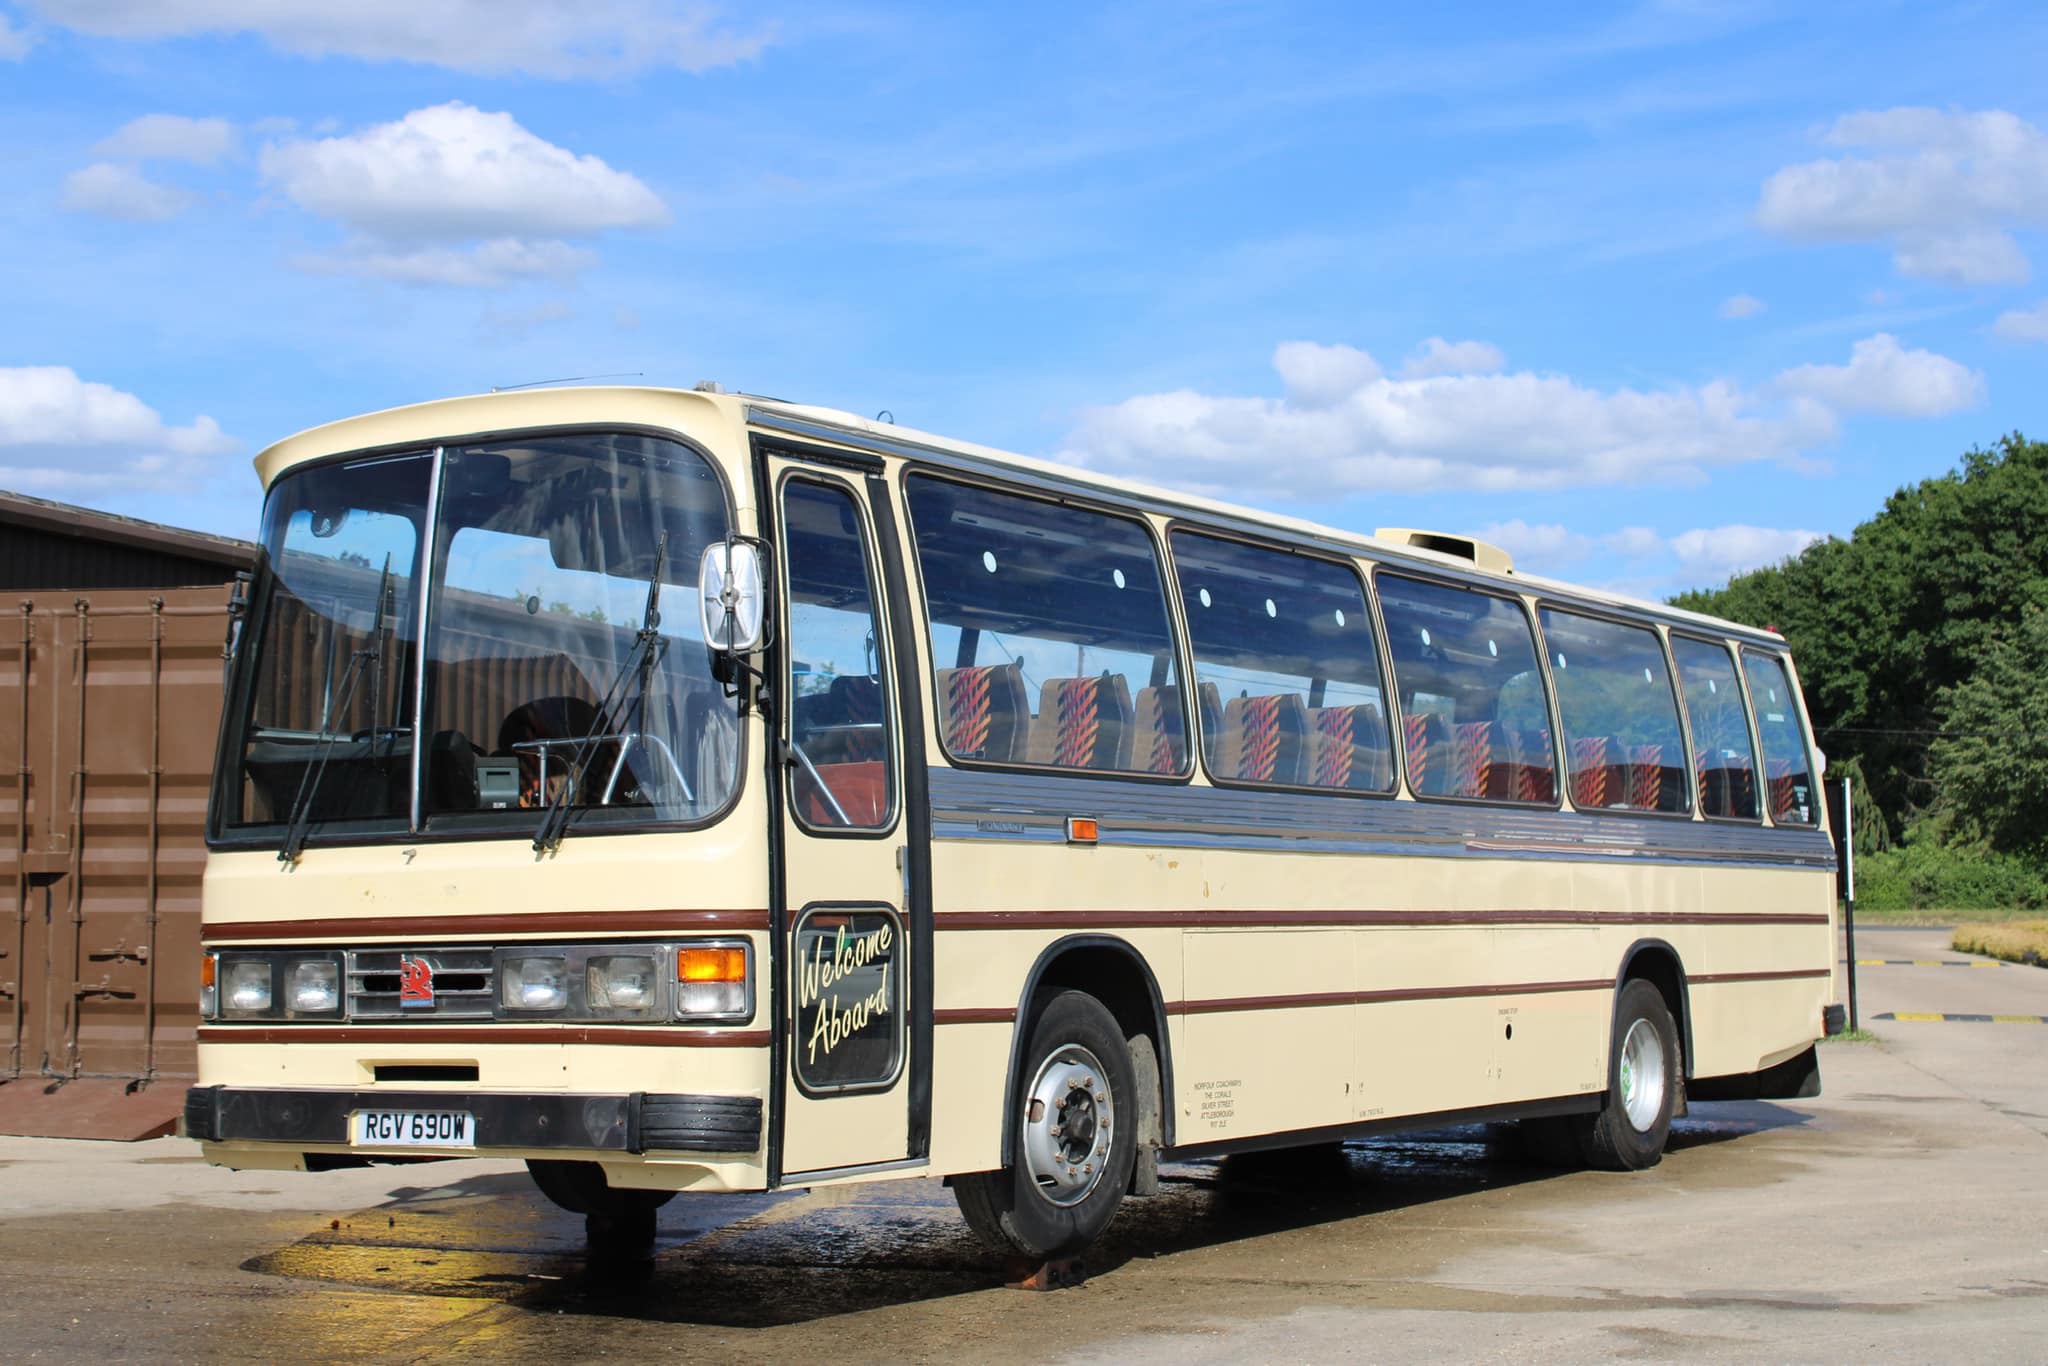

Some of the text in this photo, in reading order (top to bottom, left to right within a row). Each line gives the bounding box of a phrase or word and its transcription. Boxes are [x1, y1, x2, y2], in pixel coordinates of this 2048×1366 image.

[799, 923, 893, 1009] Welcome
[808, 962, 889, 1065] Aboard
[1194, 1081, 1214, 1090] NORFOLK
[1217, 1100, 1234, 1109] STREET
[1200, 1110, 1234, 1119] ATTLEBOROUGH
[366, 1113, 466, 1139] RGV 690W
